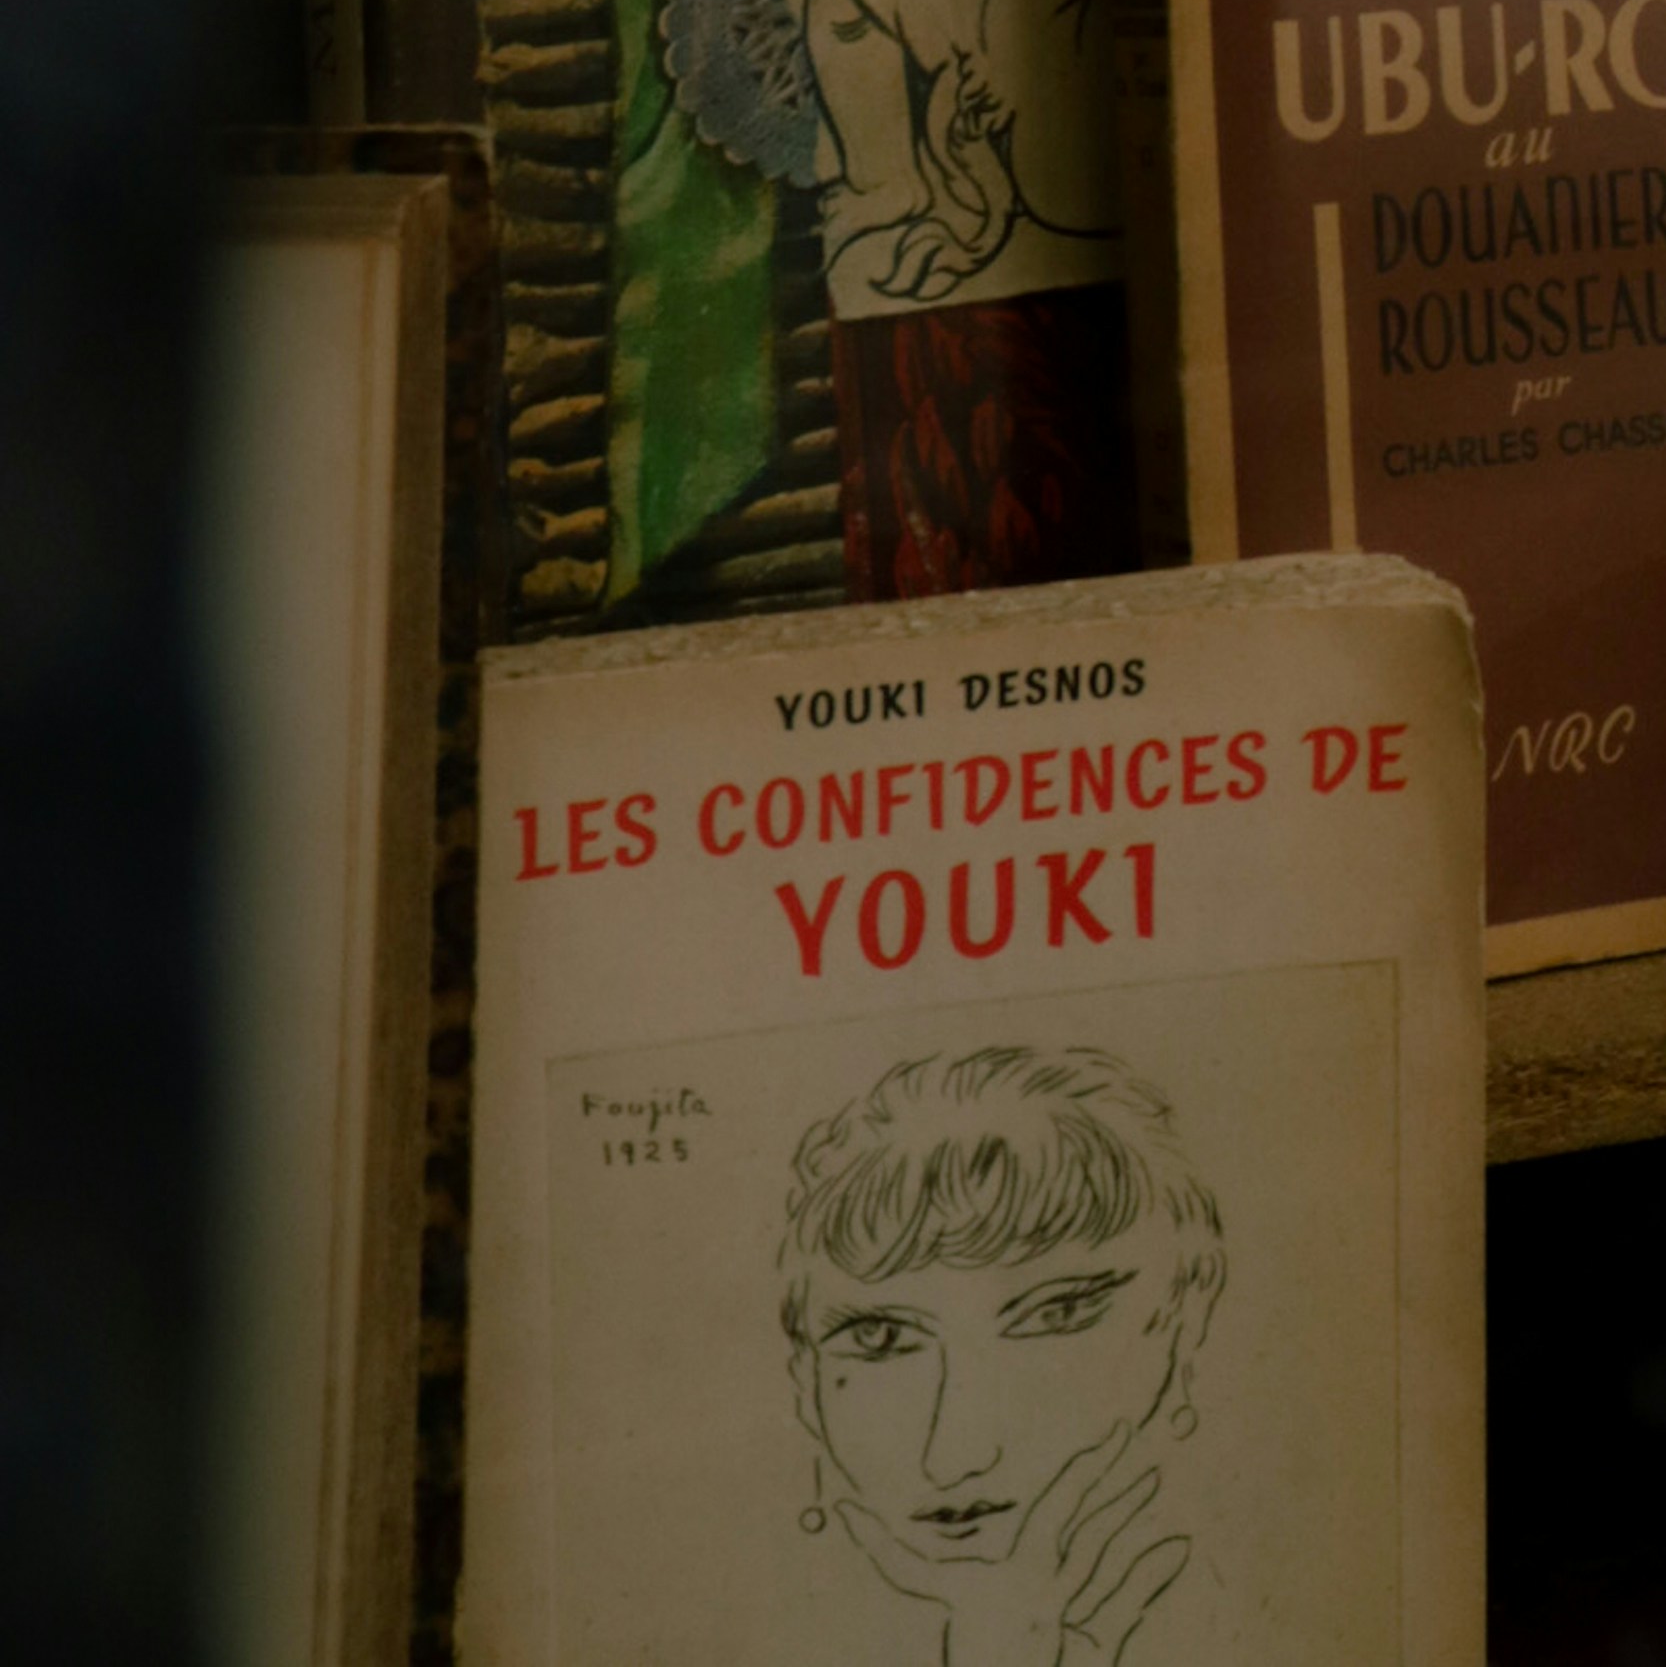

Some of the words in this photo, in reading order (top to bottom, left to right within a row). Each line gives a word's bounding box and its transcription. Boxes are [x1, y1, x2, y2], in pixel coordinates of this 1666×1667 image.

[1485, 124, 1555, 171] au
[1511, 375, 1573, 418] par
[1382, 427, 1540, 478] CHARLES
[775, 680, 927, 732] YOUKI
[958, 659, 1147, 713] DESNOS
[513, 794, 657, 883] LES
[697, 731, 1268, 859] CONFIDENCES
[1302, 723, 1410, 797] DE
[774, 843, 1157, 978] YOUKI
